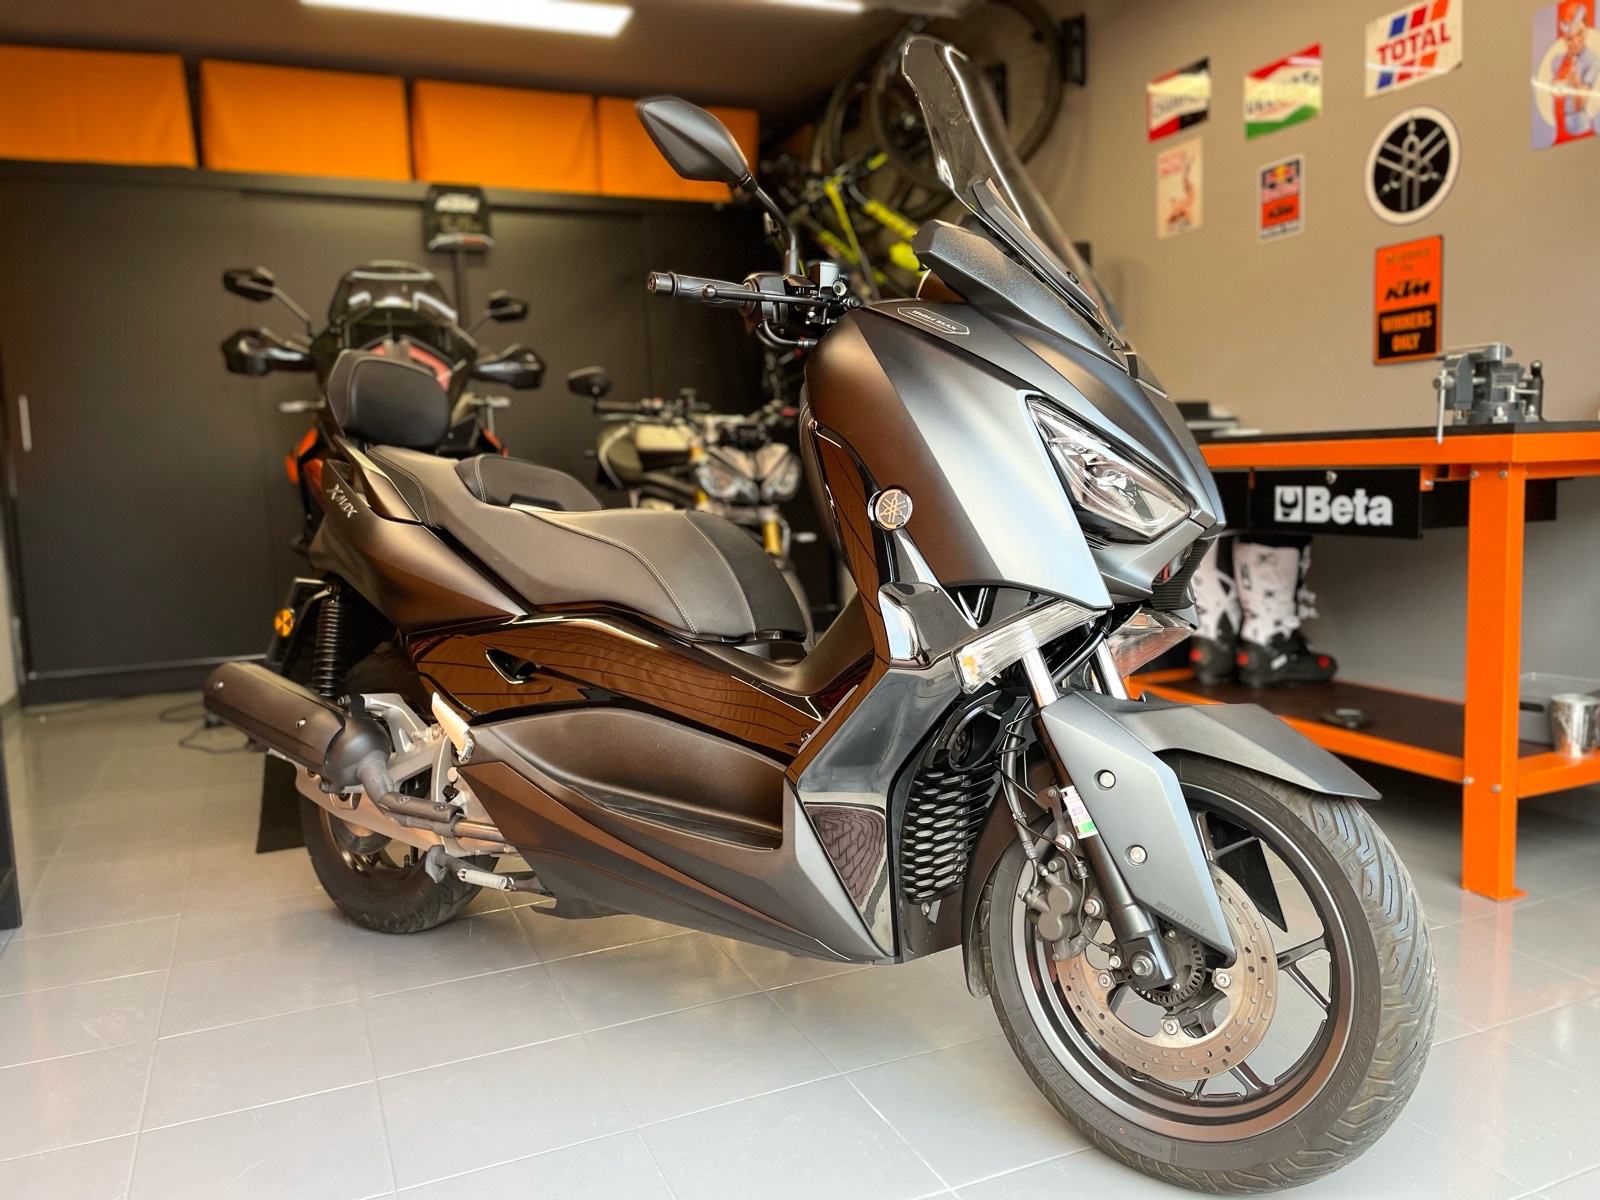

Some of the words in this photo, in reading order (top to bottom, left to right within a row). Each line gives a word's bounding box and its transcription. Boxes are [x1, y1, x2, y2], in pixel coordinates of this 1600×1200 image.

[1376, 22, 1452, 65] TOTAL
[1385, 280, 1431, 301] KTM
[1381, 310, 1432, 333] WINNERS
[1391, 332, 1421, 353] ONLY
[1304, 485, 1394, 527] Beta
